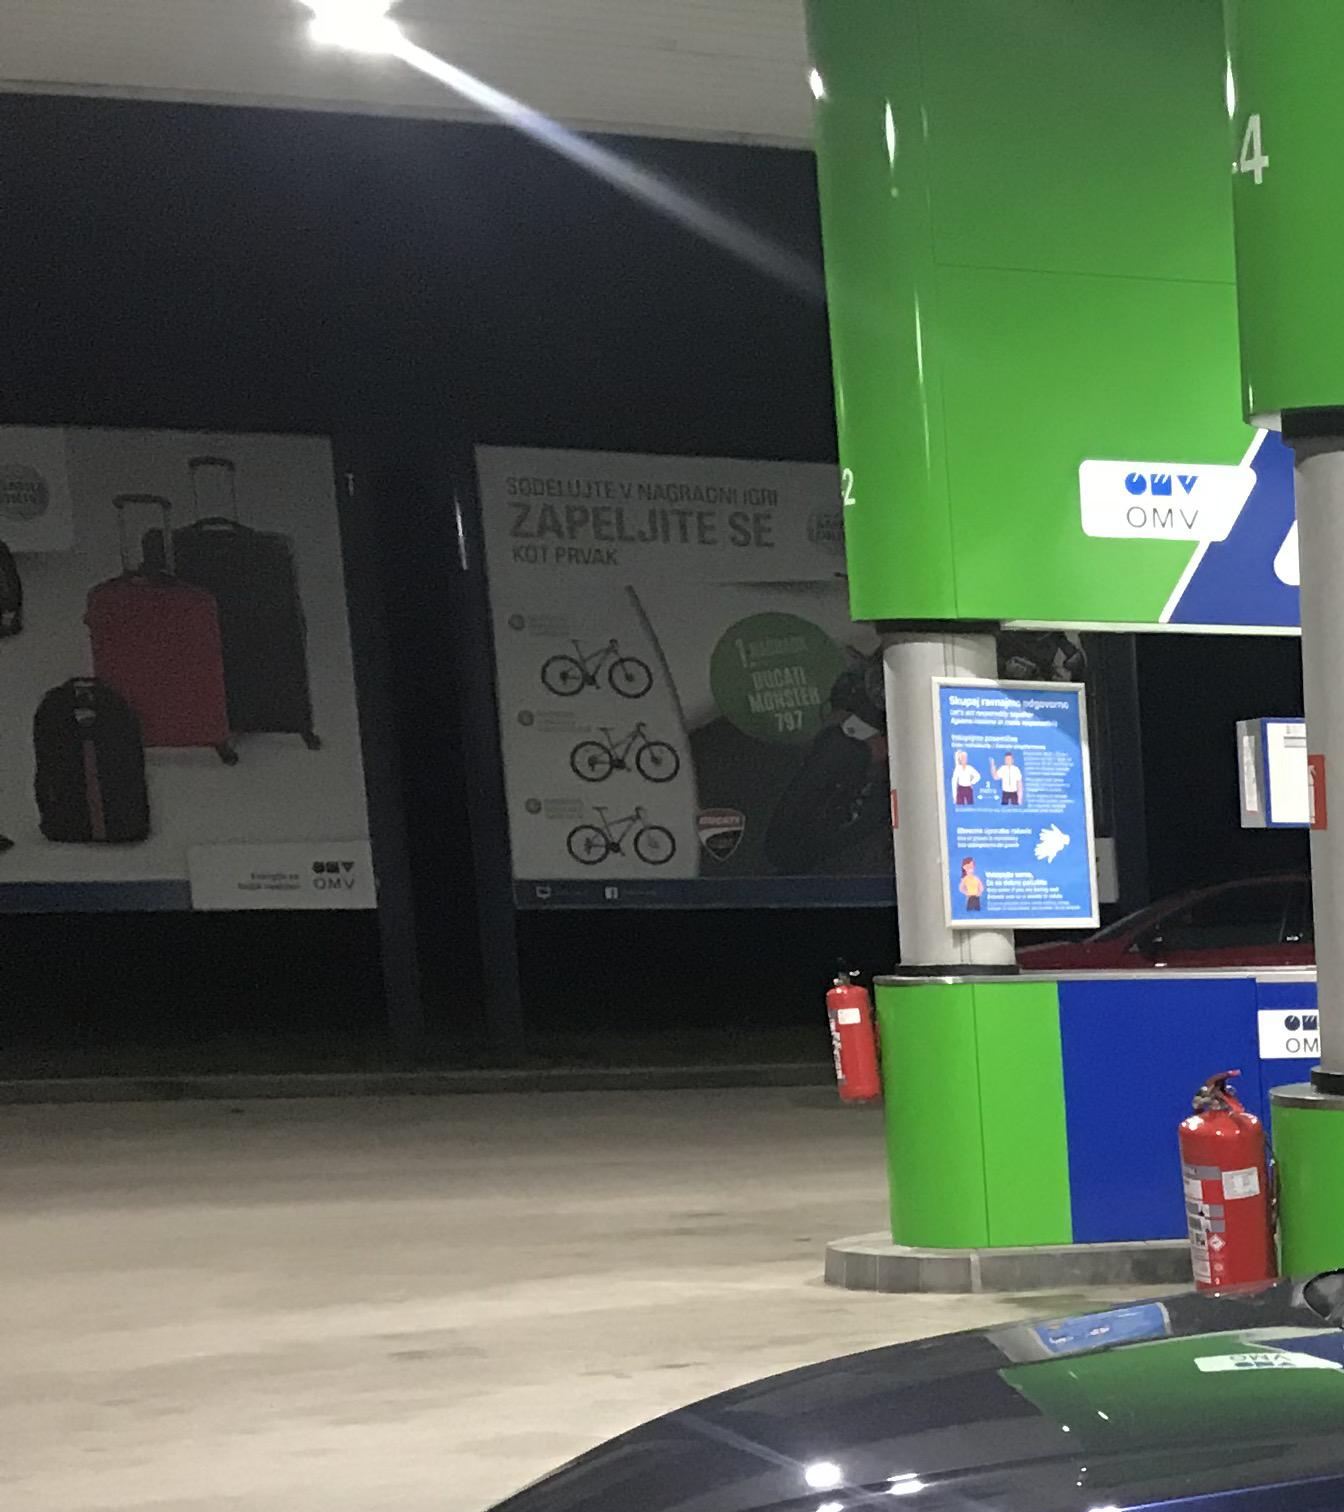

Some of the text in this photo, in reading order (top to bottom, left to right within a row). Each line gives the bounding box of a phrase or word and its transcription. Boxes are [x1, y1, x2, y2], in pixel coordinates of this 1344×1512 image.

[1240, 113, 1269, 184] 4
[841, 467, 857, 507] 2
[508, 501, 718, 546] ZAPELJITE
[729, 511, 776, 549] SE
[1126, 506, 1199, 529] OMV
[512, 544, 619, 567] KOT PRVAK
[752, 665, 807, 691] DUCATI
[313, 876, 356, 891] OMV
[1285, 1037, 1319, 1053] OM
